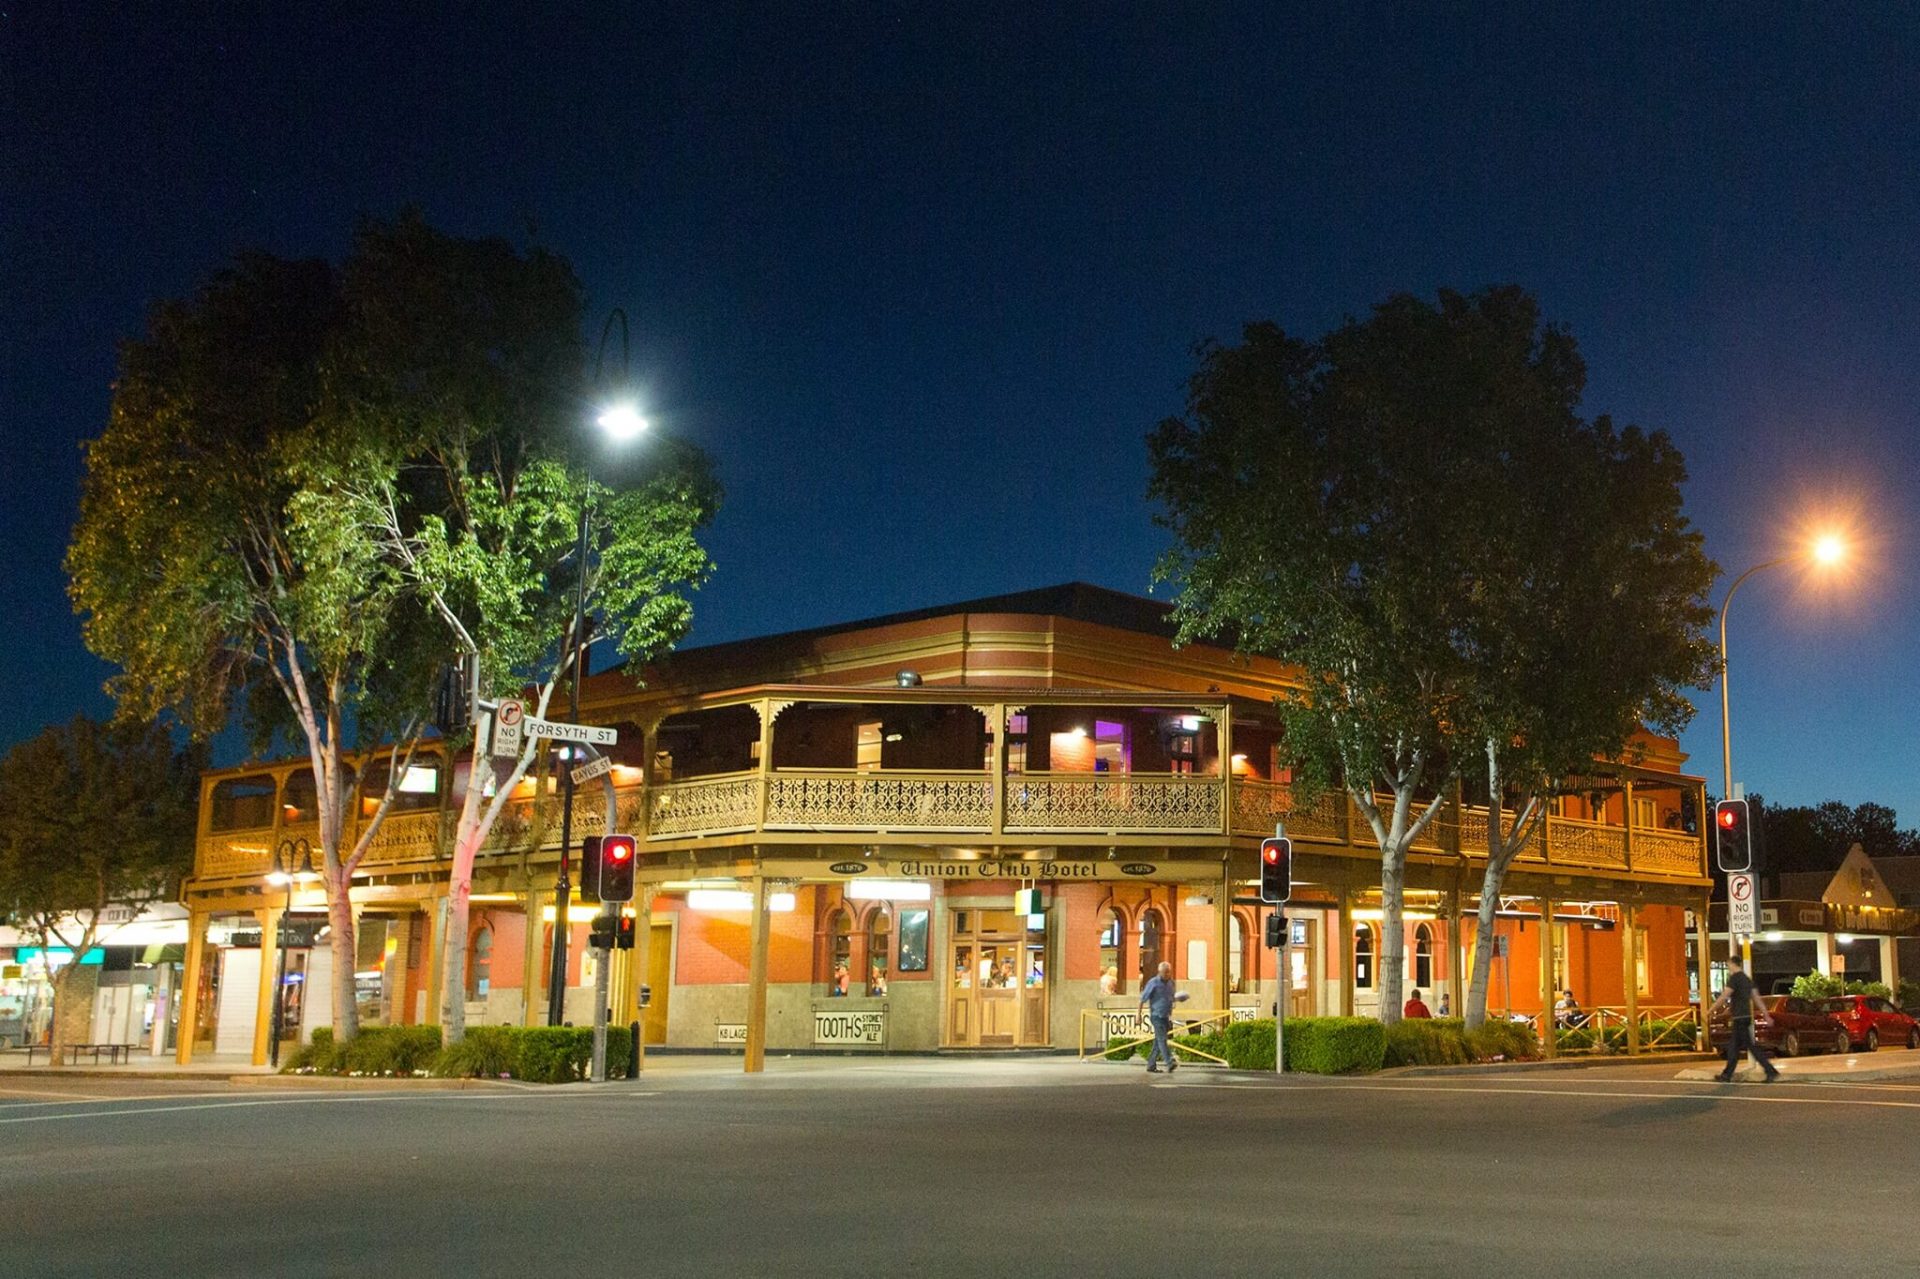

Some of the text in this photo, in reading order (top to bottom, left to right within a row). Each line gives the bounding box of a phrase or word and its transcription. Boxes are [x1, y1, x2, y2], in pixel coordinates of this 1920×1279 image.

[501, 728, 516, 737] NO
[529, 723, 612, 742] FORSYTH ST
[497, 738, 517, 746] RIGHT
[497, 746, 516, 754] TURN
[573, 759, 609, 782] BAYLIS ST
[901, 860, 1098, 879] Union Club Hotel
[1735, 903, 1749, 912] NO
[1733, 914, 1752, 922] RIGHT
[1734, 922, 1753, 931] TURN
[862, 1014, 883, 1023] SYDNEY
[816, 1014, 862, 1039] TOOTH'S
[862, 1023, 881, 1032] BITTER
[719, 1029, 747, 1039] KB LAGE
[866, 1032, 878, 1042] ALE
